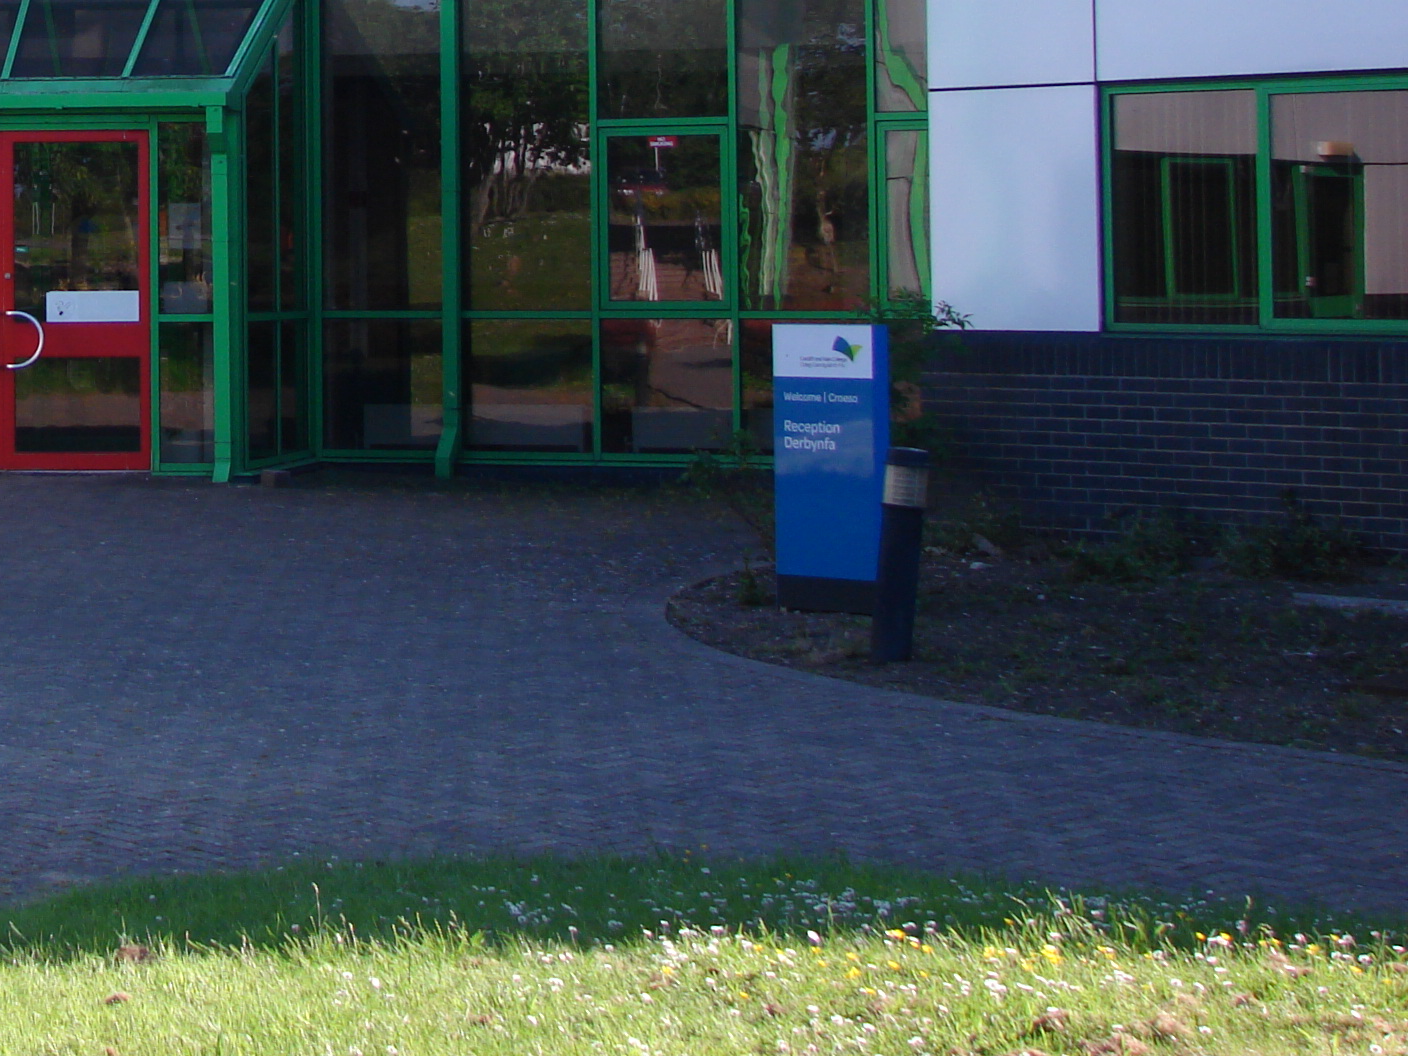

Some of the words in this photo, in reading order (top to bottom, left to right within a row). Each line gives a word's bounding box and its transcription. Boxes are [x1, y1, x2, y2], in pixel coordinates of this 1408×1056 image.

[783, 391, 822, 402] Welcome
[828, 392, 858, 403] Croeso
[783, 419, 841, 435] Reception
[783, 436, 836, 452] Derbynfa
